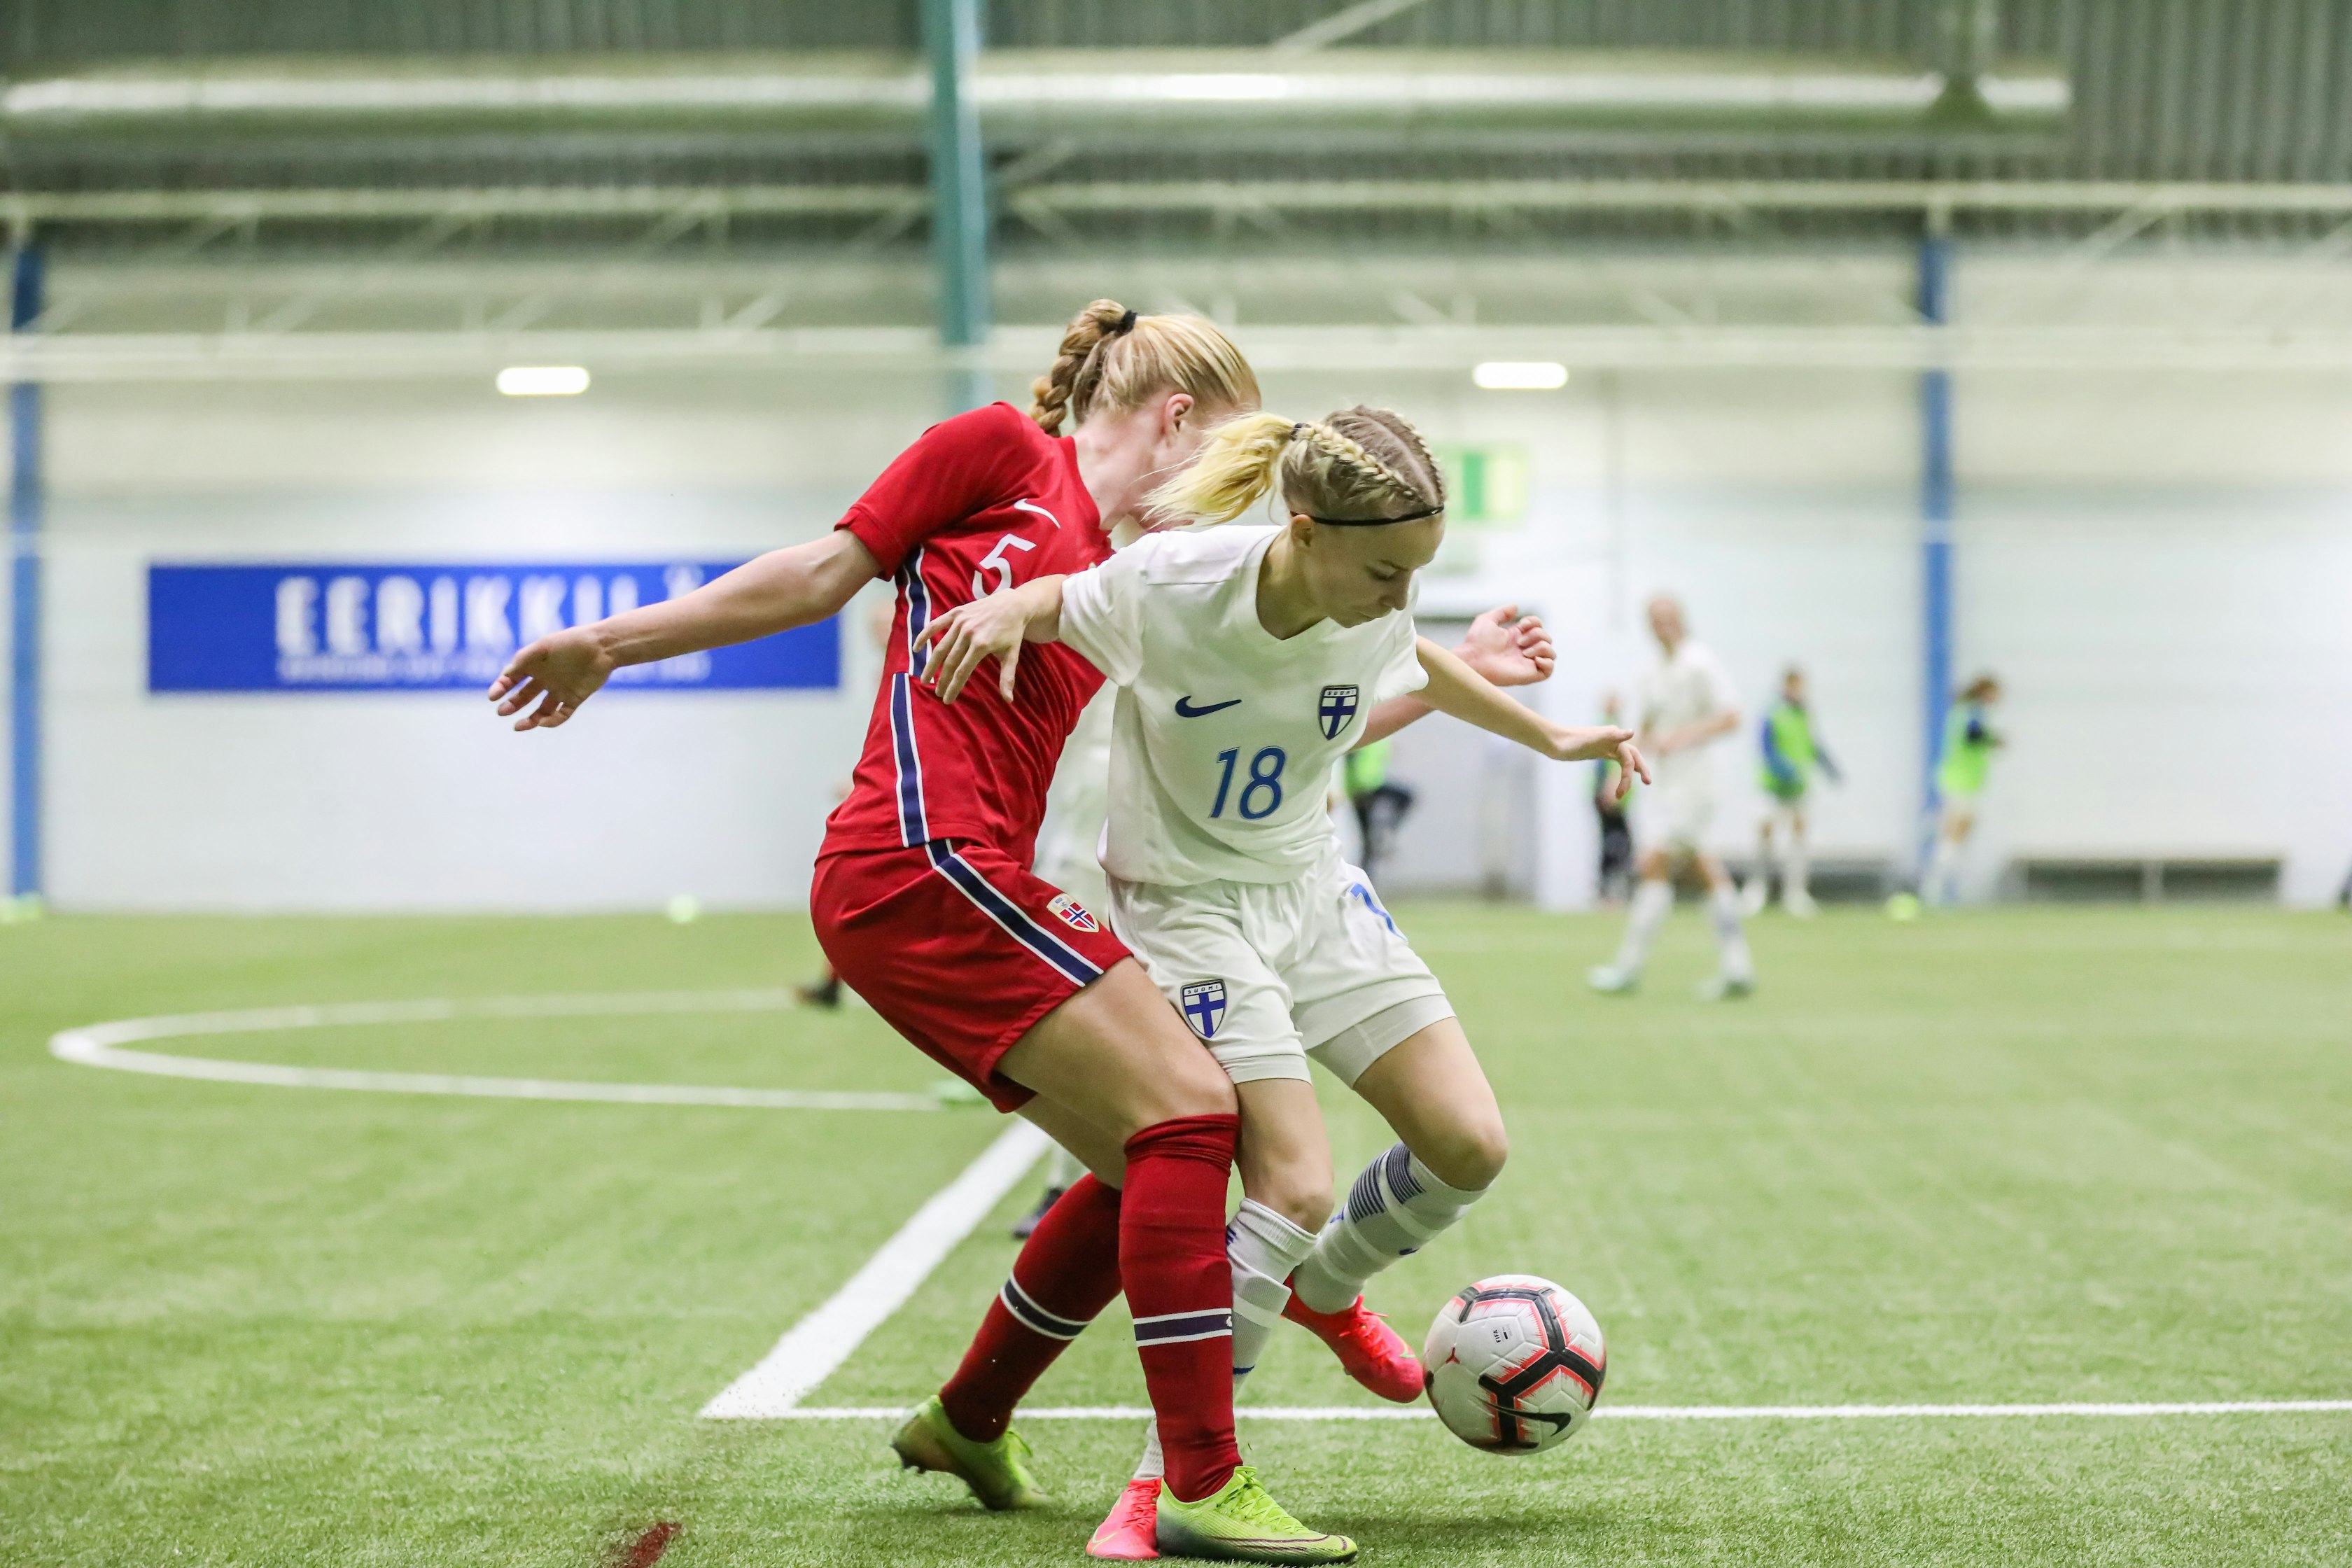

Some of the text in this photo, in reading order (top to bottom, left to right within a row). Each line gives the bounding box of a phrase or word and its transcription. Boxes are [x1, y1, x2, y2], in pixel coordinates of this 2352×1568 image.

[972, 533, 1037, 601] 5
[1208, 746, 1285, 820] 18
[1187, 984, 1218, 995] SUOMI
[1493, 1329, 1502, 1343] FIFA
